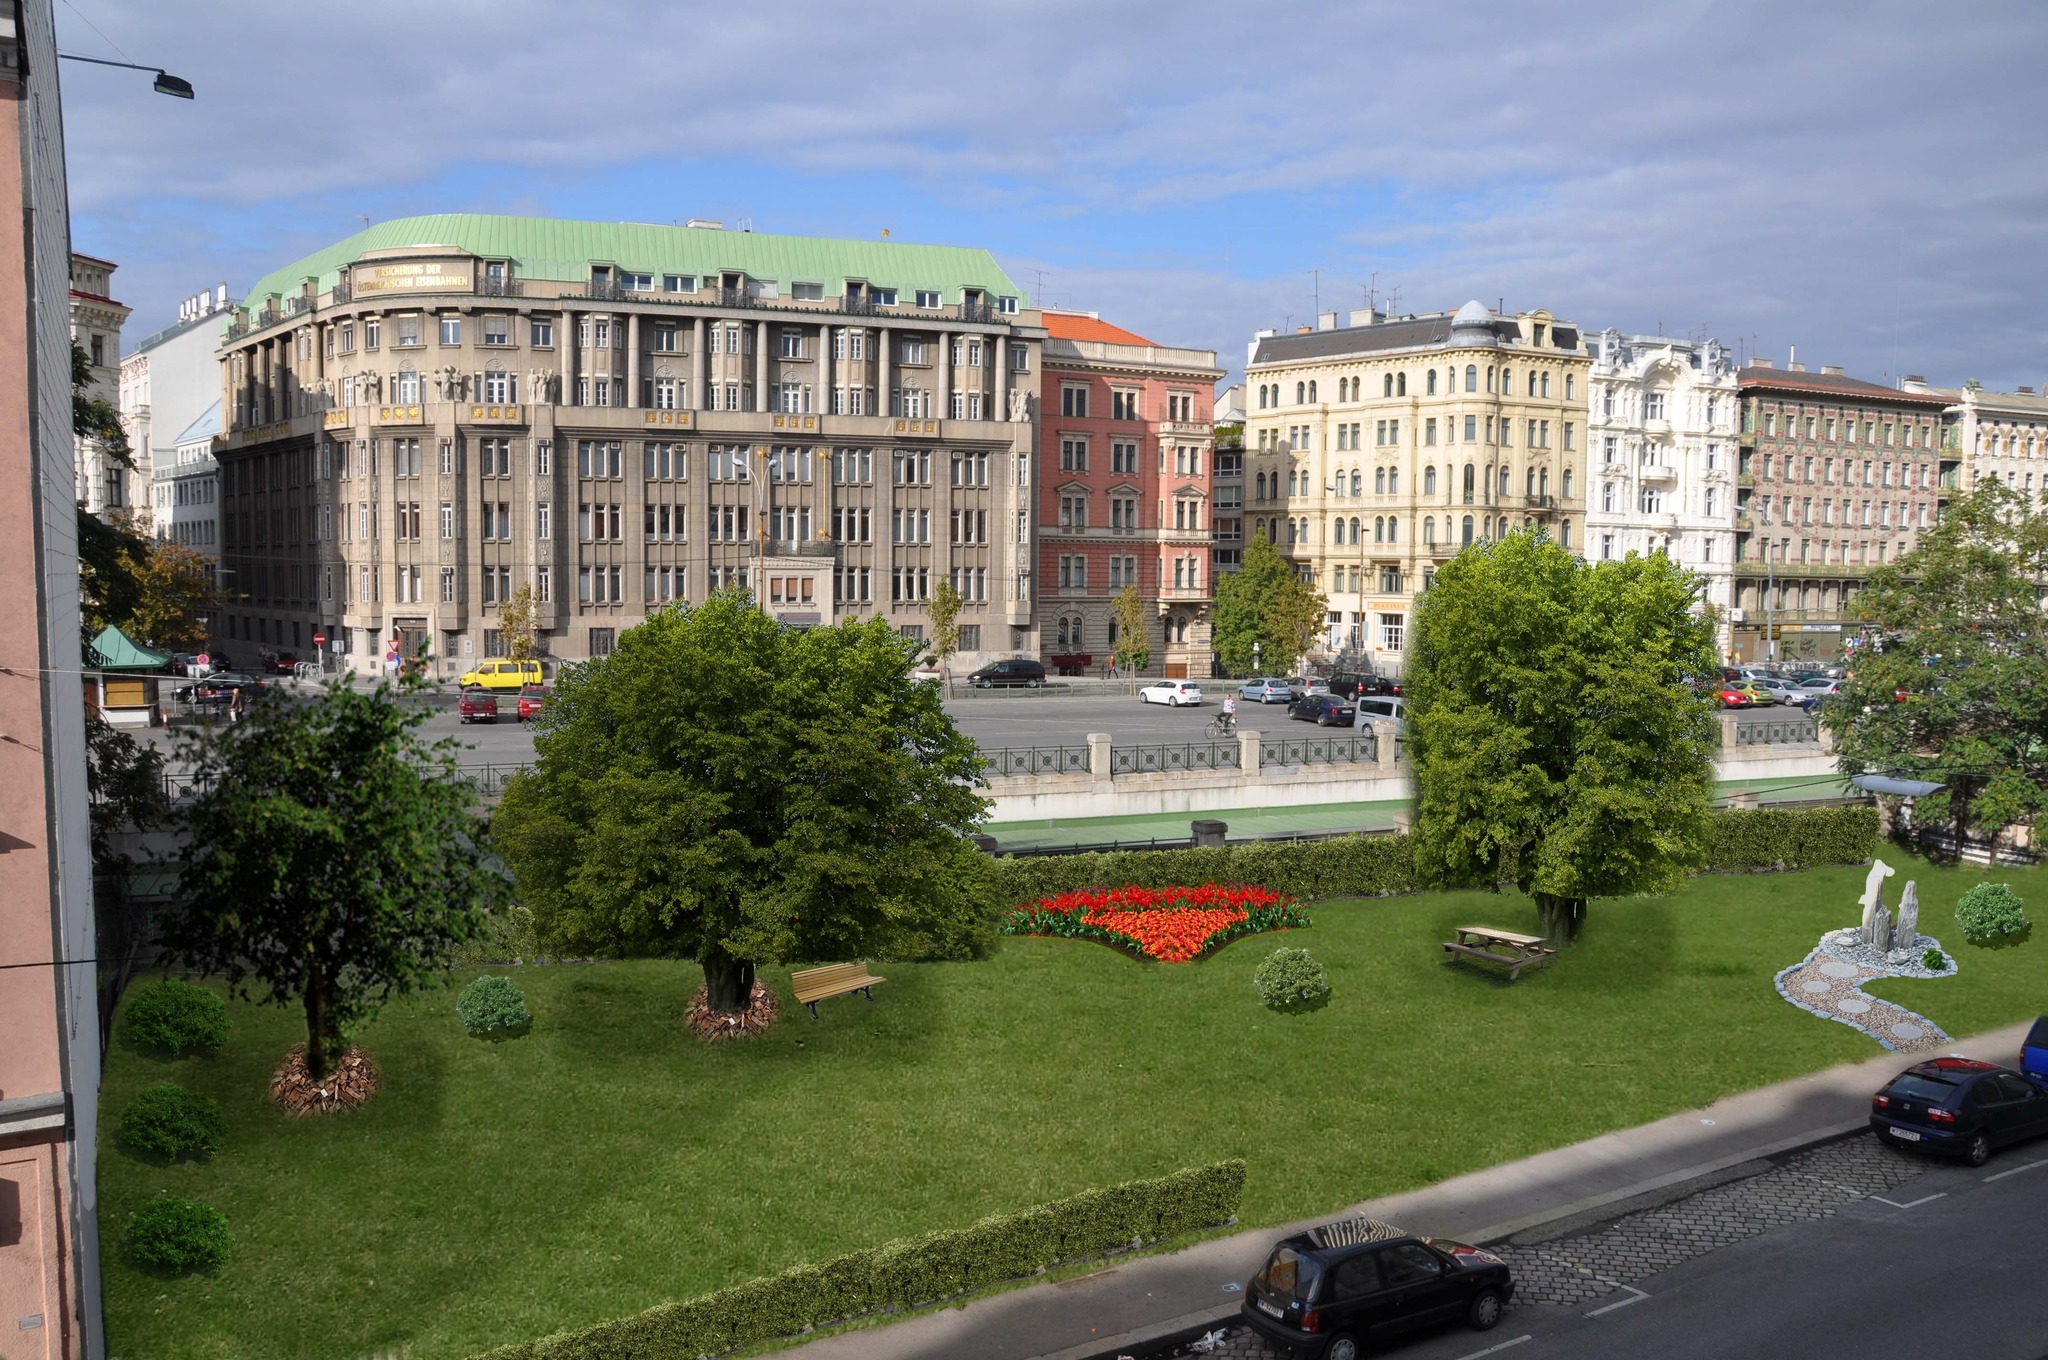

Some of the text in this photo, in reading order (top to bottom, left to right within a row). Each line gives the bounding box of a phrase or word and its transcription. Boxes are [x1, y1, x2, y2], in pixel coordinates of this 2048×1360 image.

[375, 264, 441, 277] VERSICHERUNG DER
[415, 276, 468, 287] EISENBAHNEN
